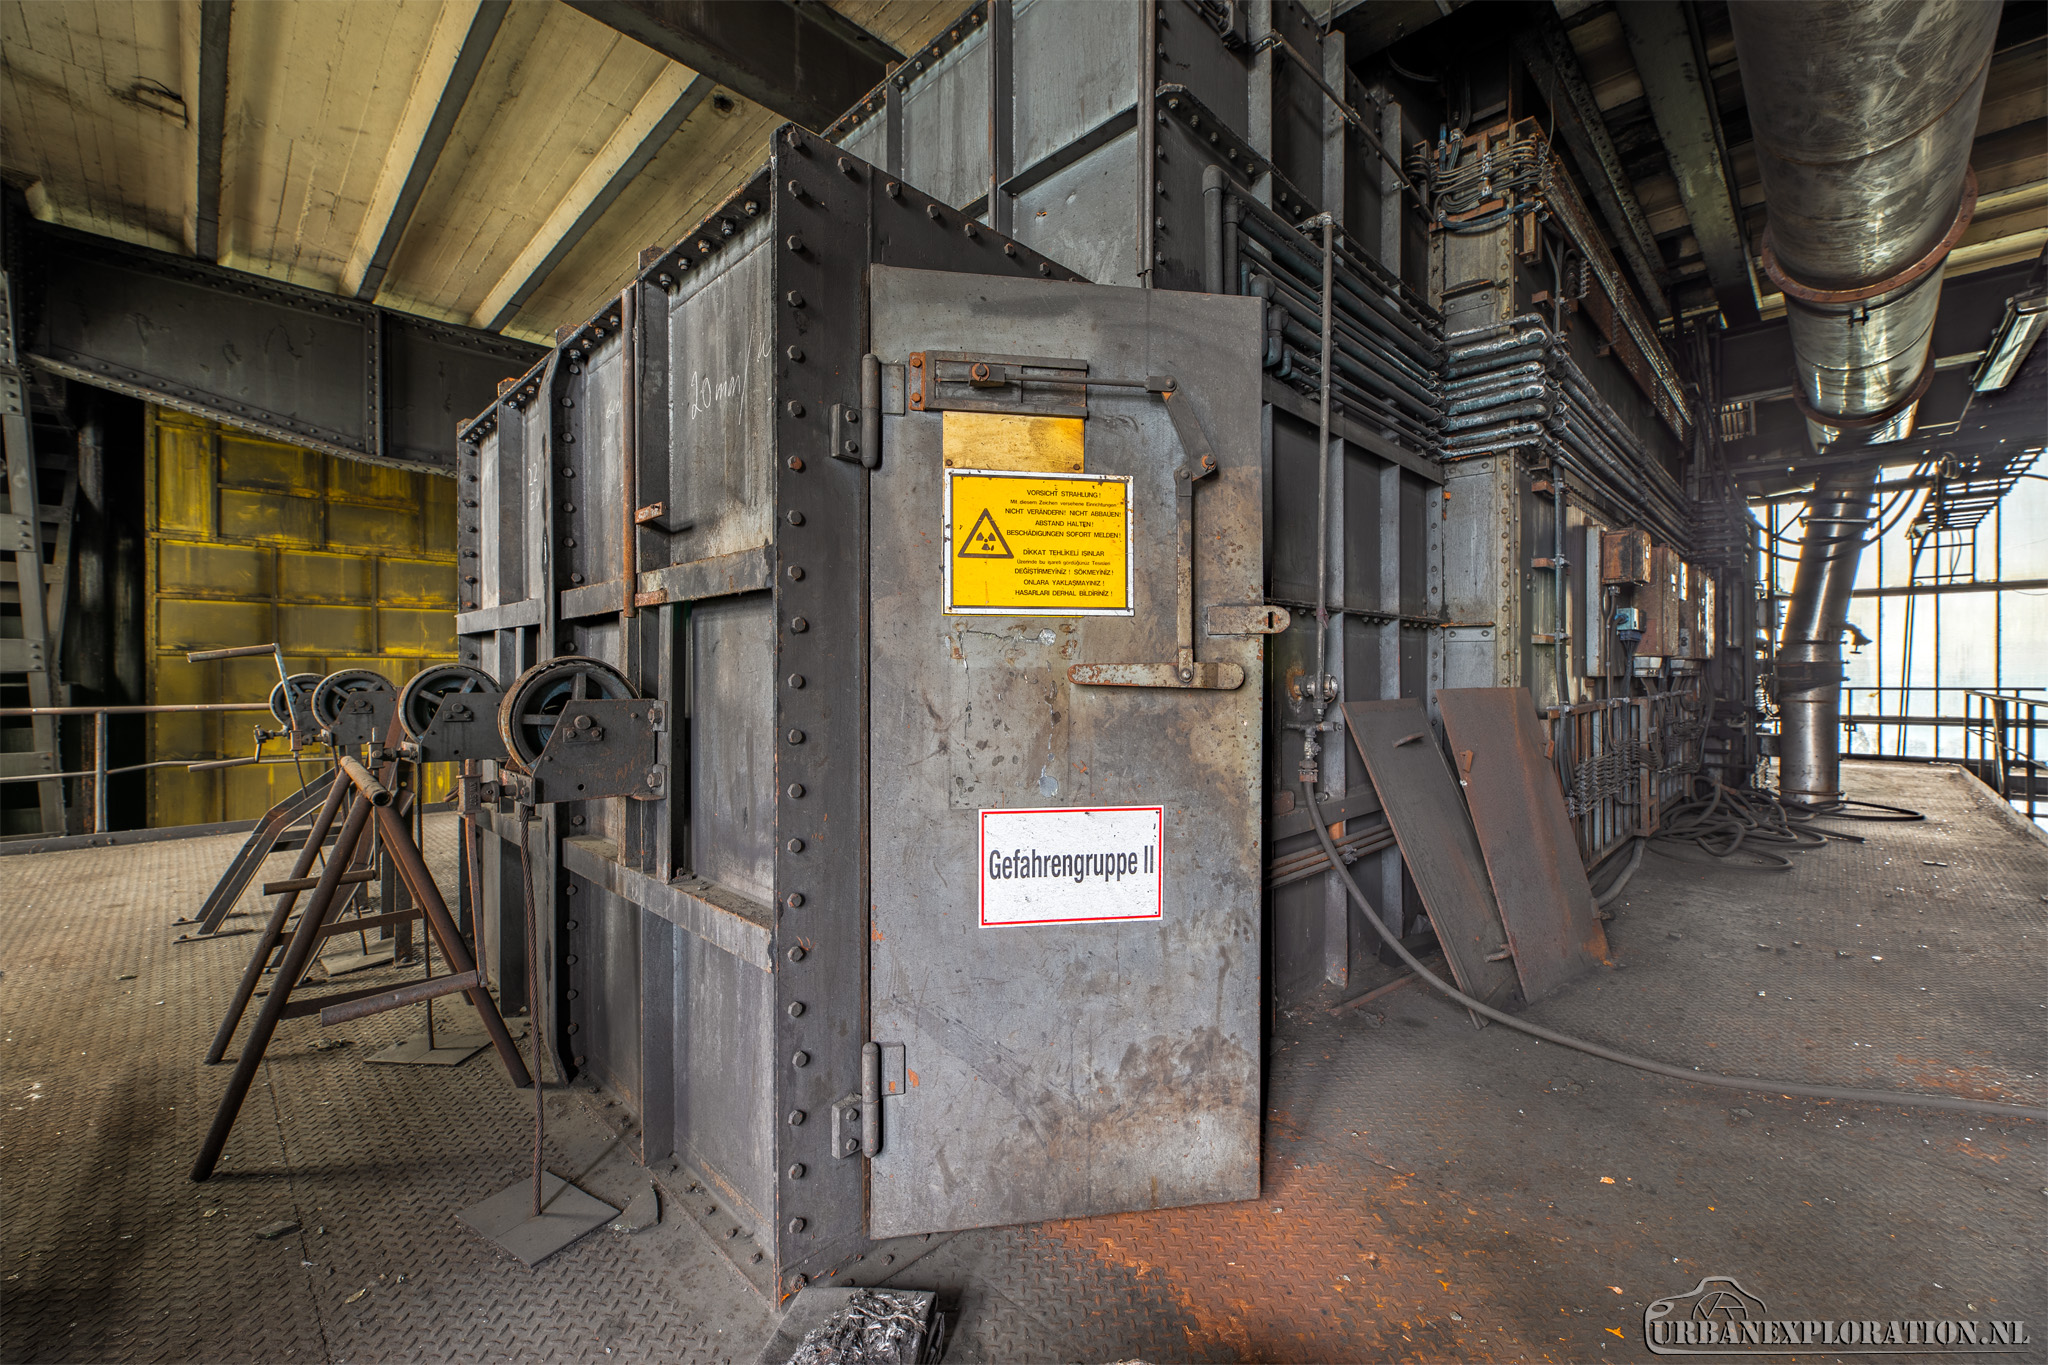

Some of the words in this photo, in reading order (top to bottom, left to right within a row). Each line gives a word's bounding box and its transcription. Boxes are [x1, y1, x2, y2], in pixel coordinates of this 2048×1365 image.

[1060, 490, 1102, 498] STRAHLUNG!
[1026, 508, 1066, 516] VERÄNDERN!
[1006, 529, 1064, 537] BESCHÄDIGUNGEN
[1022, 548, 1046, 556] DİKKAT
[989, 848, 1138, 884] Gefahrengruppe
[1143, 845, 1154, 874] II
